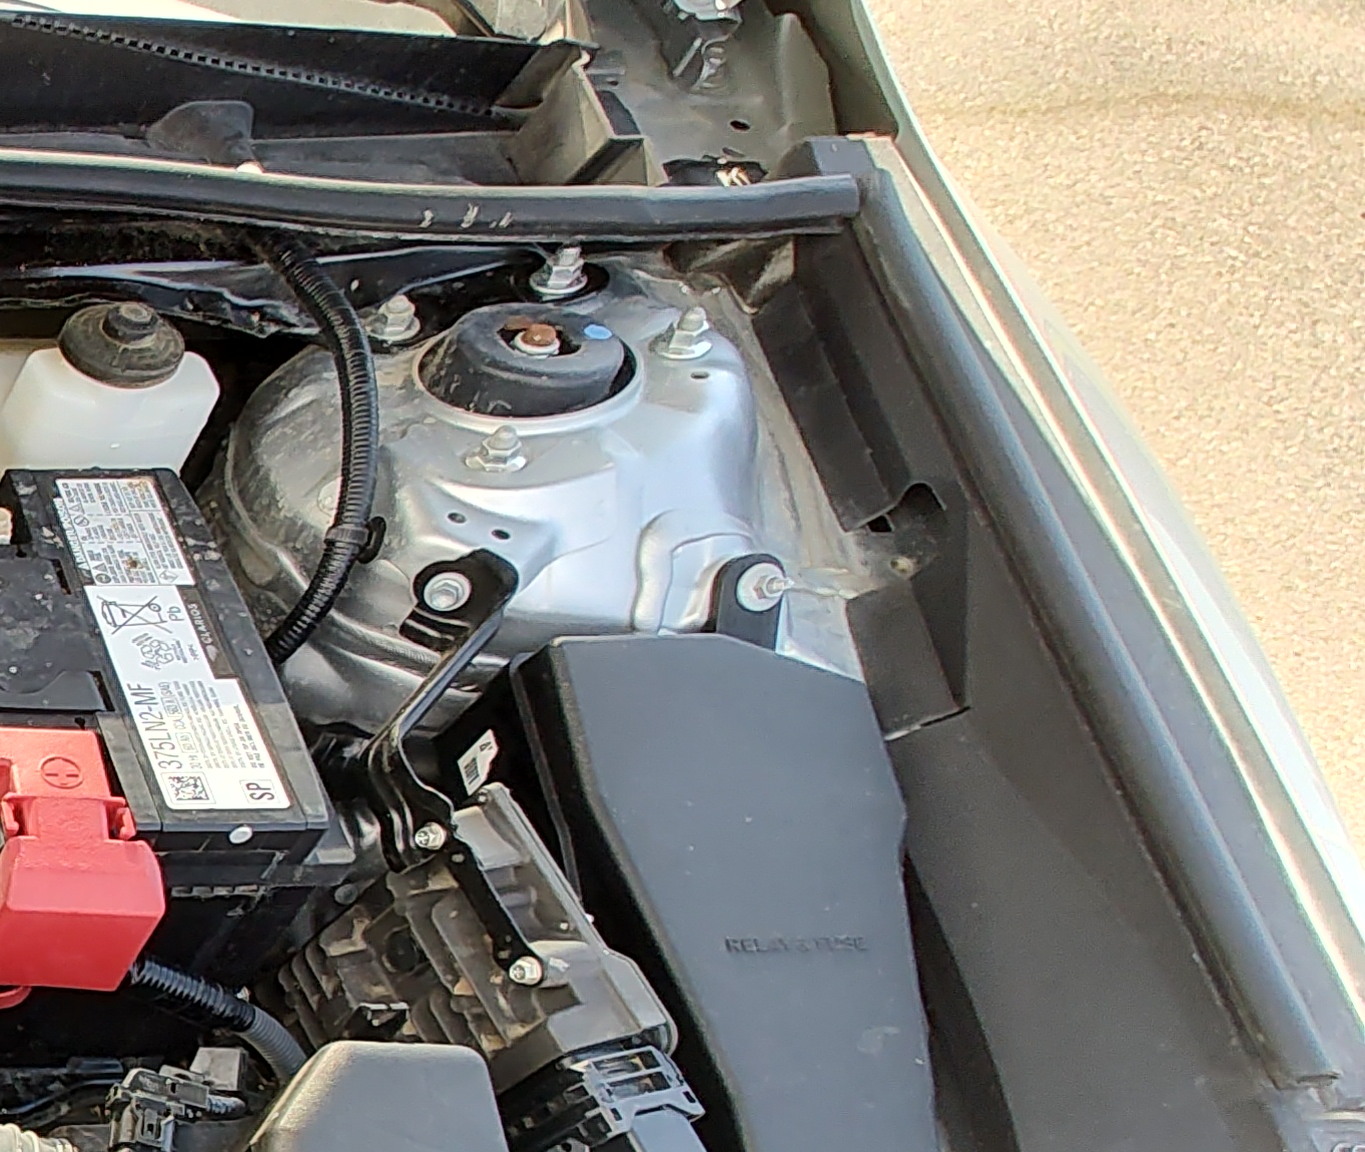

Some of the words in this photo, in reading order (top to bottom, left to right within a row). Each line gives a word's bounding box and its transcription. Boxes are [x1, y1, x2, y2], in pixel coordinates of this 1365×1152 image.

[166, 606, 185, 622] Pb
[188, 603, 213, 644] CLARIOS
[126, 682, 183, 770] 375LN2-MF
[246, 782, 275, 801] SP
